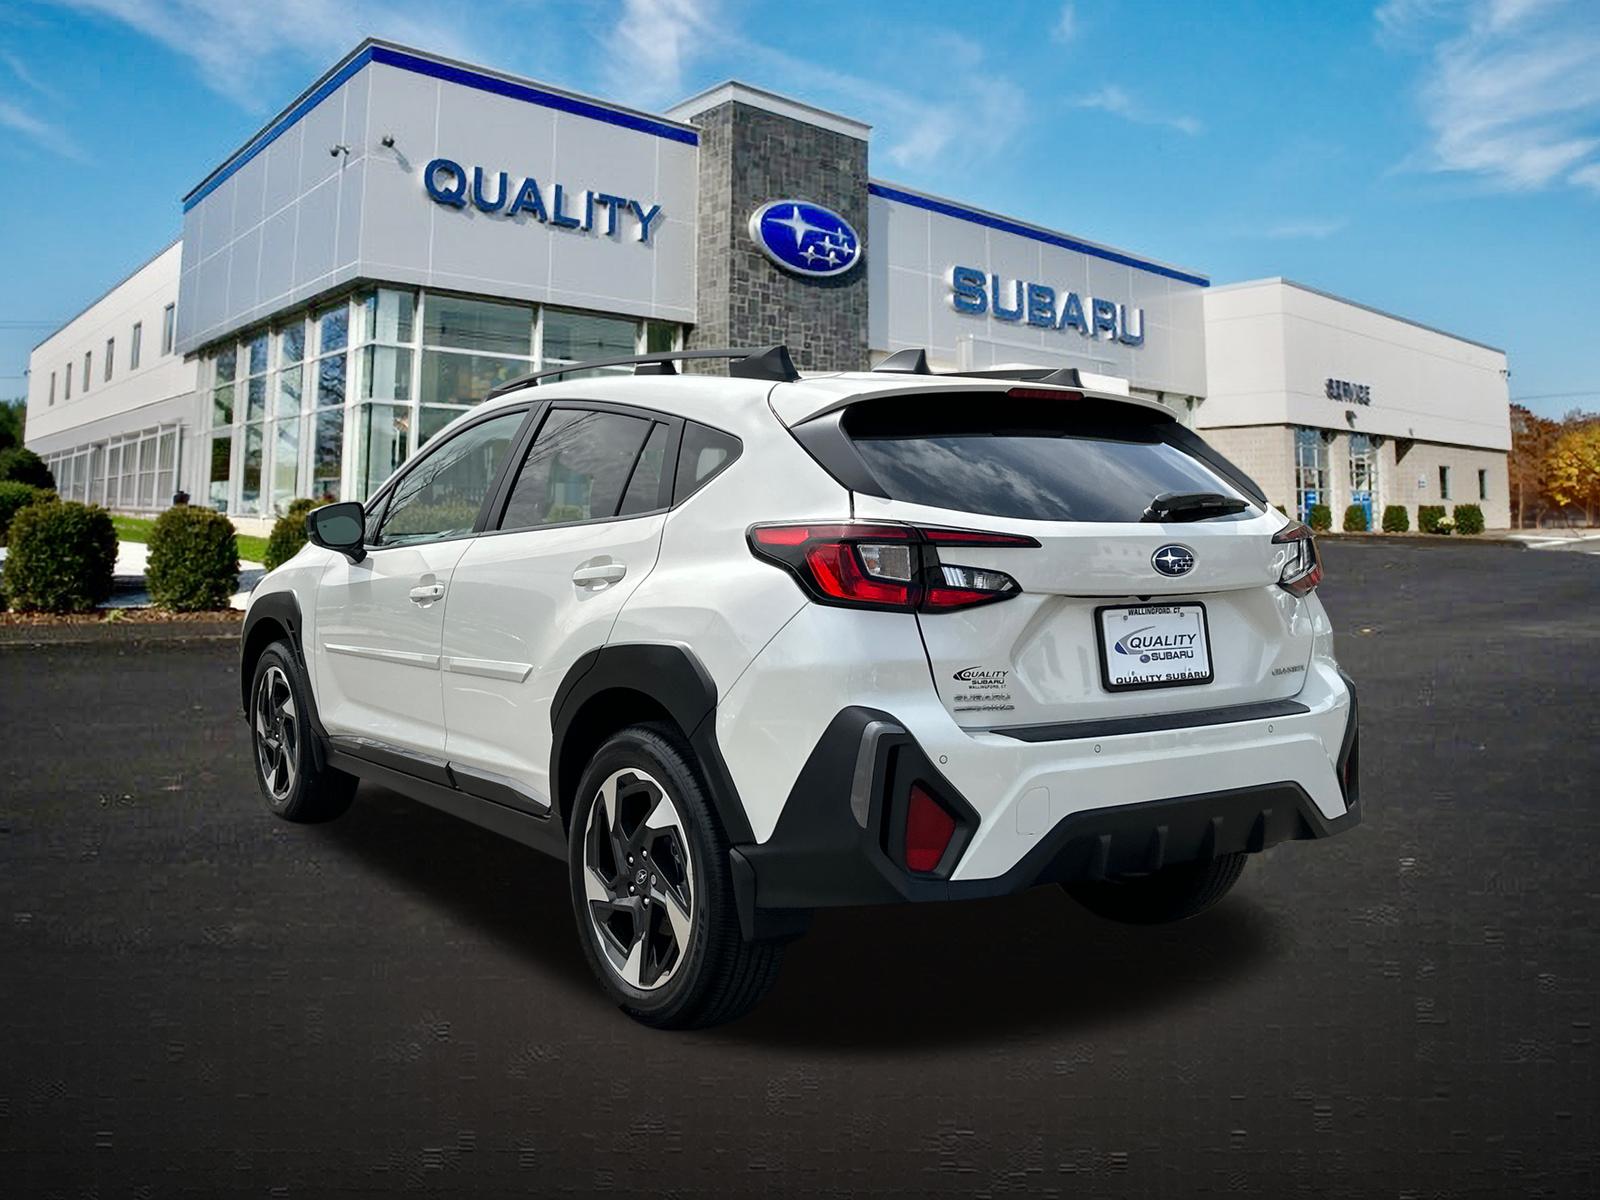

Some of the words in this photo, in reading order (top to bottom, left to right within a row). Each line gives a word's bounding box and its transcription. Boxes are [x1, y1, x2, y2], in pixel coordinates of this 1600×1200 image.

[423, 158, 661, 243] QUALITY
[949, 265, 1145, 346] SUBARU
[1325, 378, 1371, 406] SERVICE
[1129, 633, 1197, 649] QUALITY
[1151, 650, 1194, 661] SUBARU
[1115, 674, 1162, 684] QUALITY
[1165, 671, 1208, 680] SUBARU
